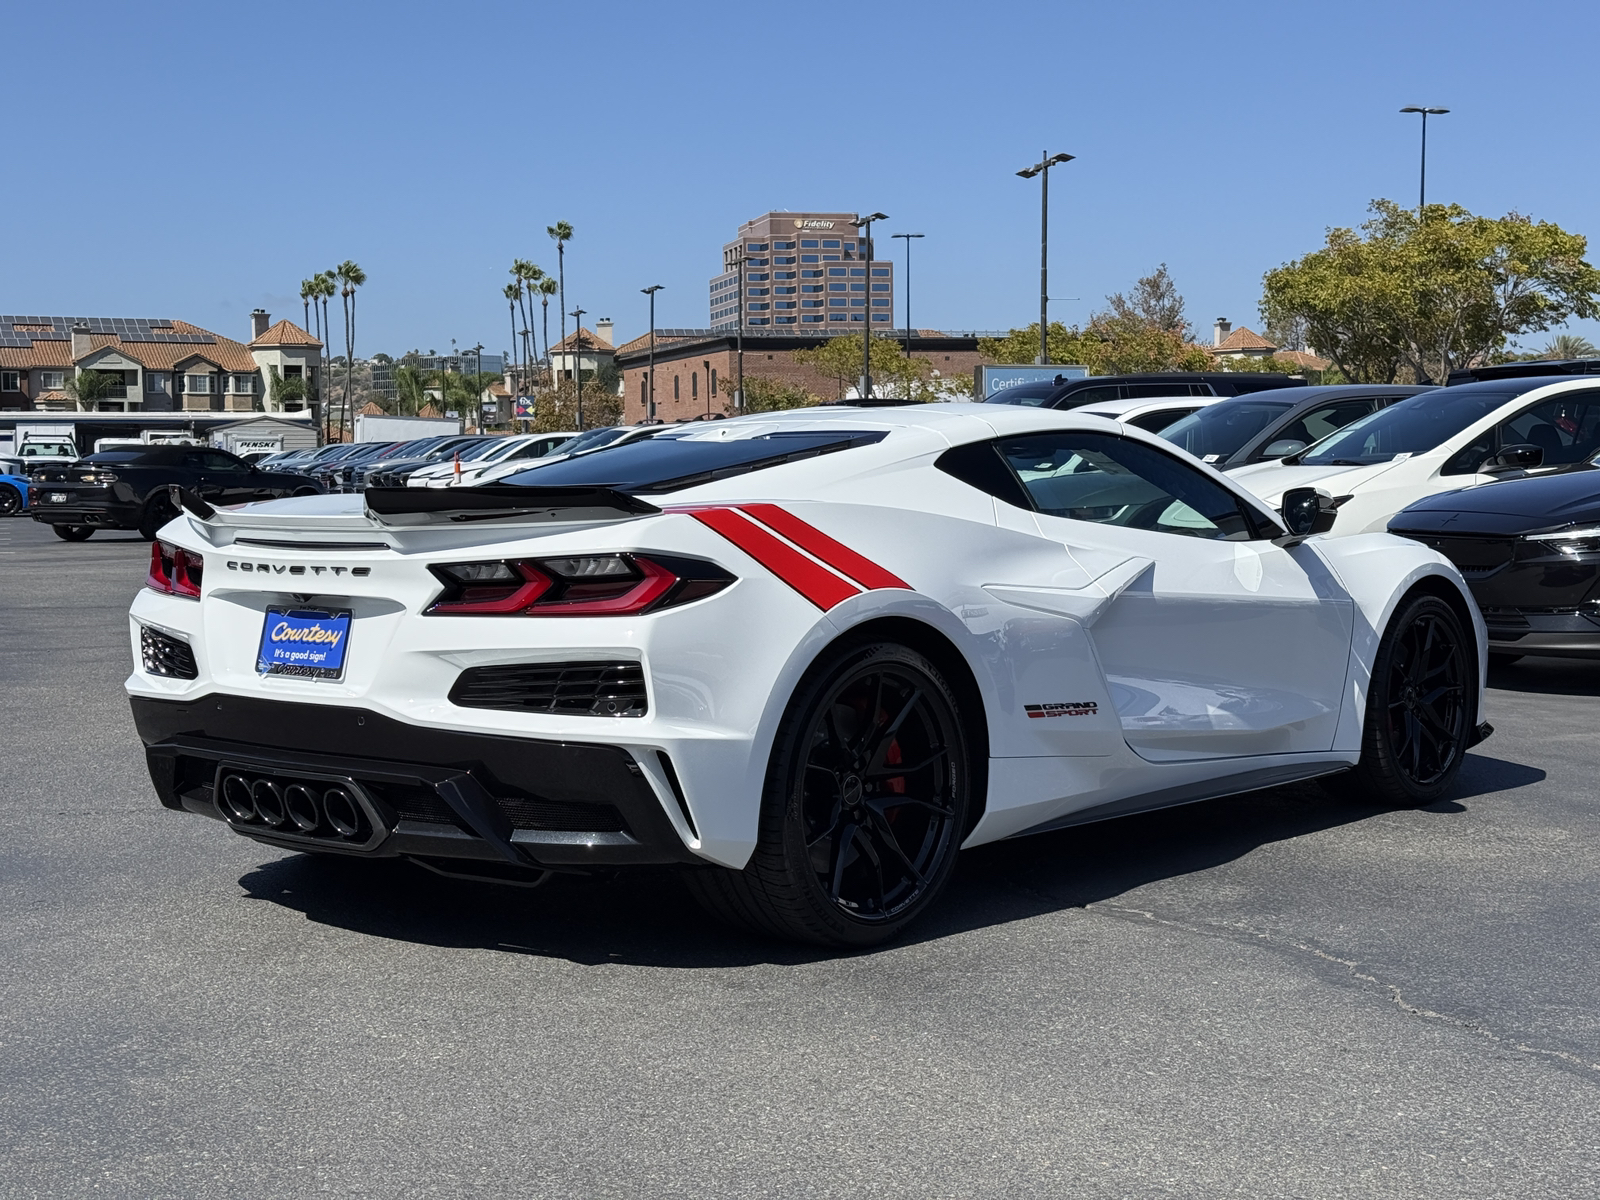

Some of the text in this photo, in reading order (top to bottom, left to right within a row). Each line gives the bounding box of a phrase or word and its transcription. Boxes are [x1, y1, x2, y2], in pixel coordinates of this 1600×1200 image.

[803, 220, 835, 230] Fidelity
[991, 377, 1038, 391] Certif
[226, 560, 371, 577] CORVETTE
[271, 621, 343, 649] Courtesy
[274, 648, 284, 658] It's
[290, 649, 310, 661] good
[309, 650, 327, 663] sign!
[1042, 701, 1098, 710] GRAND
[1045, 708, 1099, 718] SPORT
[890, 888, 920, 913] CORVETTE
